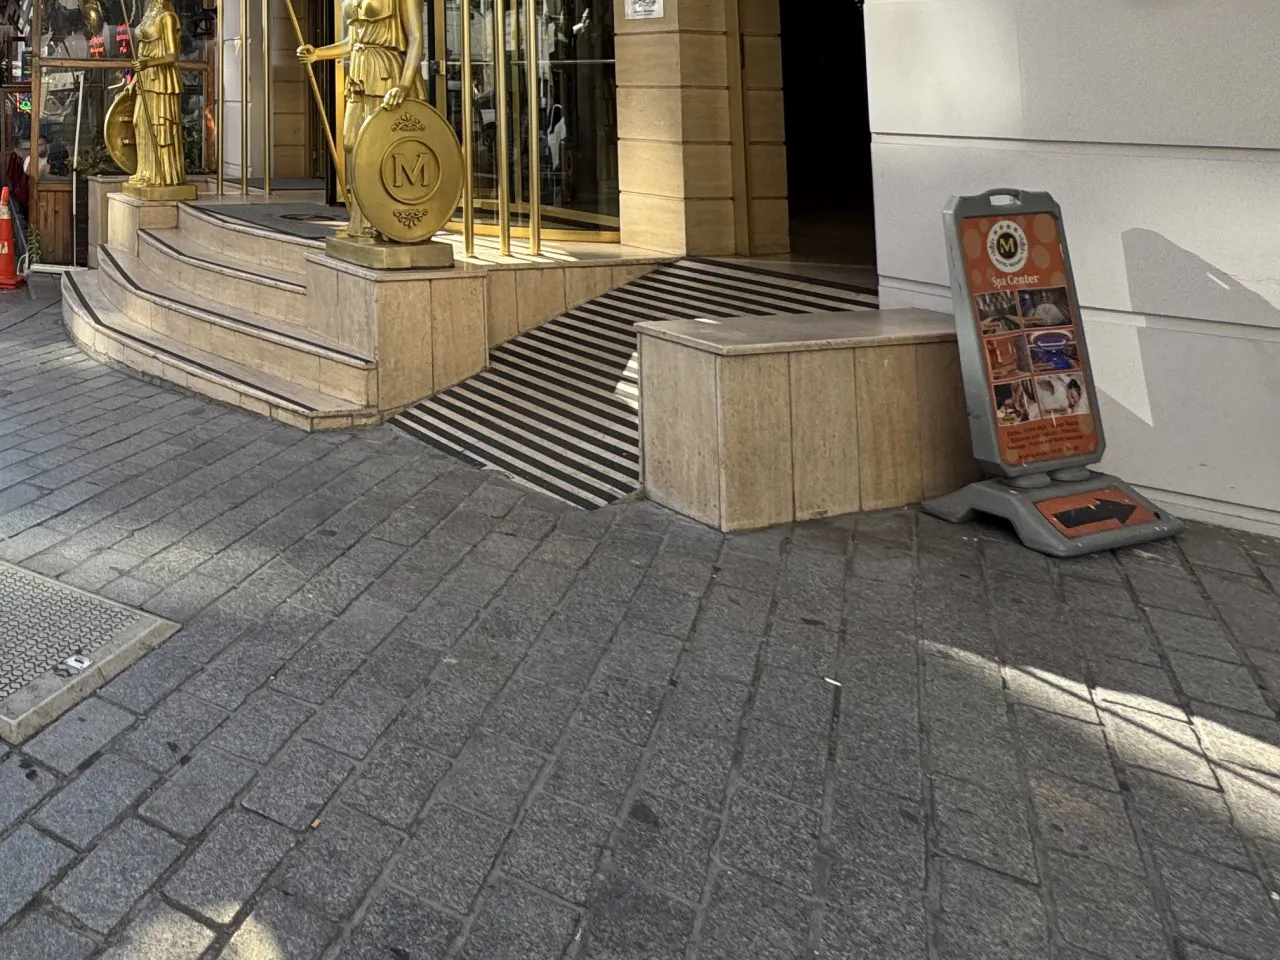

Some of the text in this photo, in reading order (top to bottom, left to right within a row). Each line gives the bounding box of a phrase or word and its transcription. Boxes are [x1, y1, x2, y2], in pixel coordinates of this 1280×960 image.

[391, 152, 431, 189] M
[999, 237, 1015, 254] M
[992, 274, 1040, 288] Spa Center
